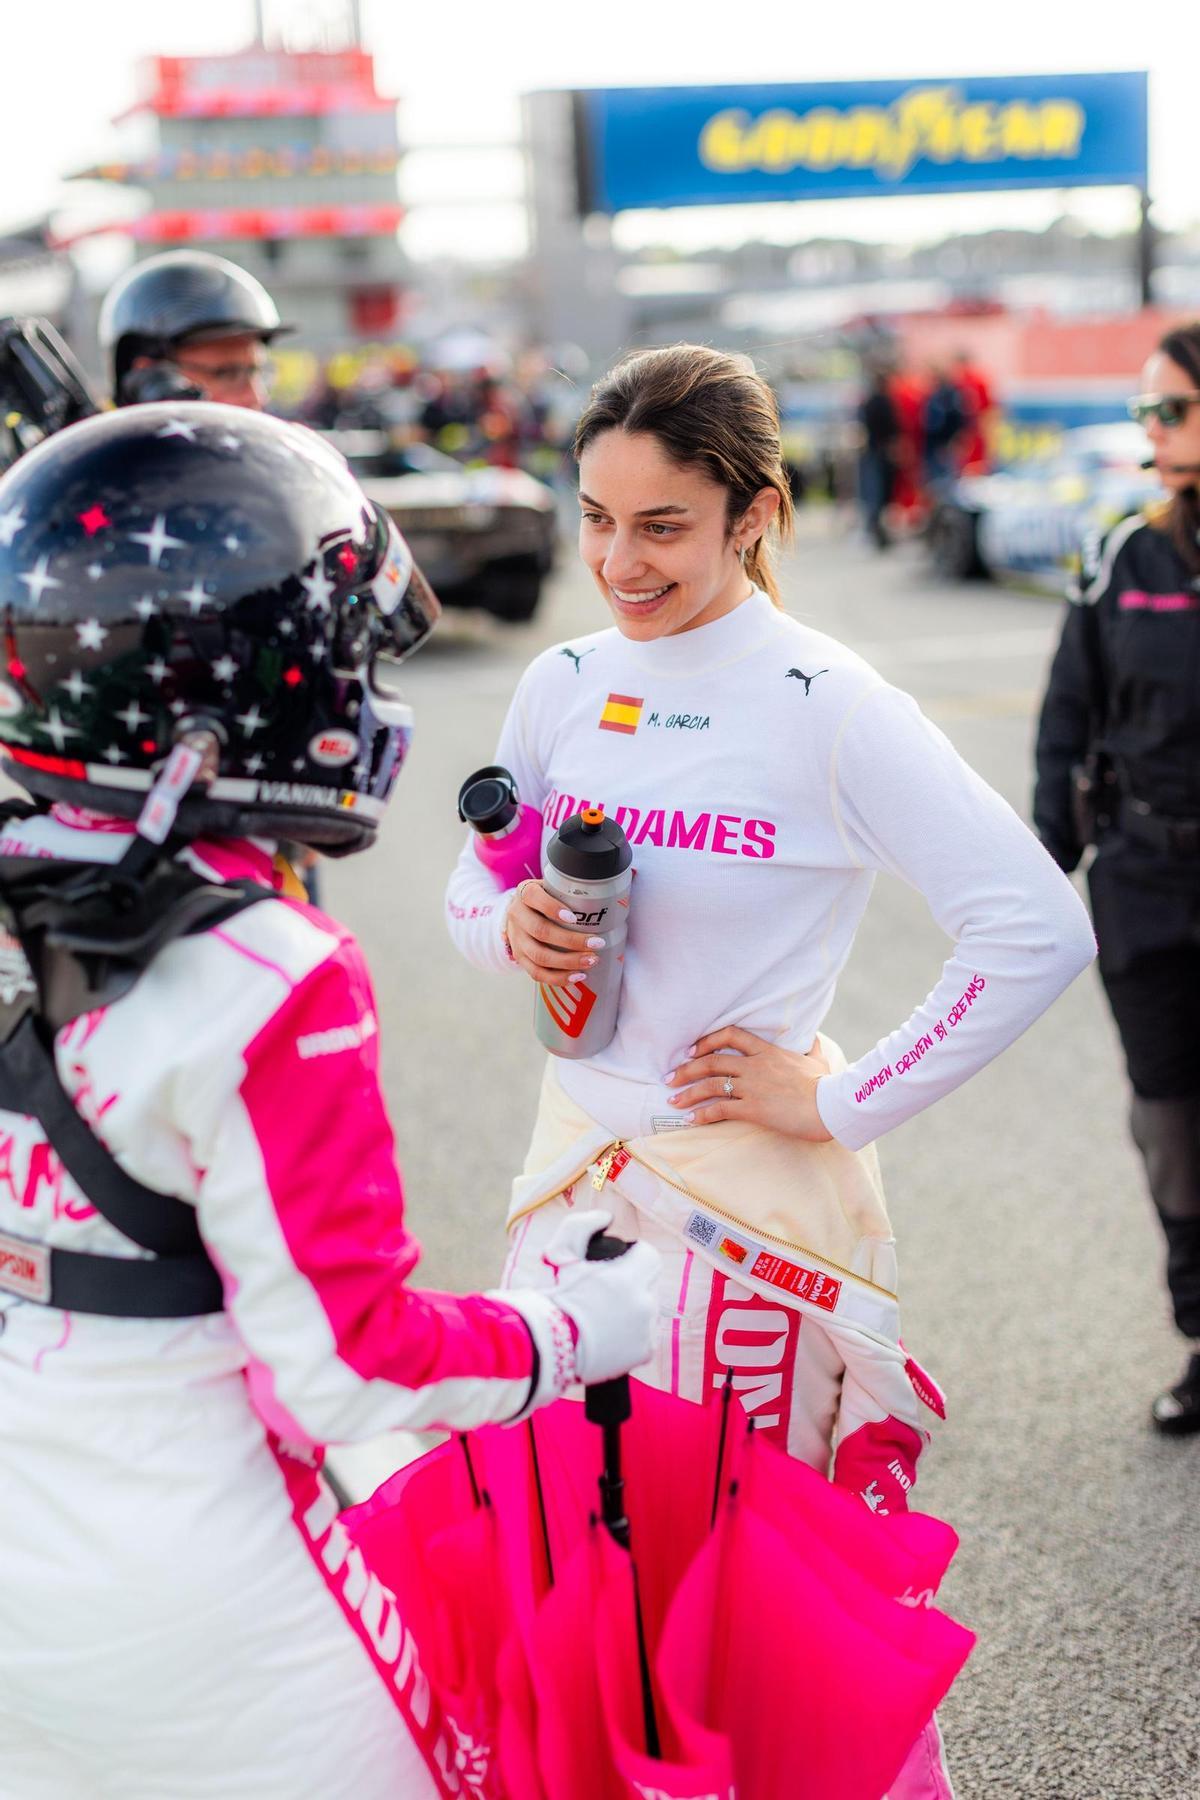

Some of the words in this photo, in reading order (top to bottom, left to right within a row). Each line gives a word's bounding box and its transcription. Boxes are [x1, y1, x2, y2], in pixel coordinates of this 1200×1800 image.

[647, 712, 661, 727] M.
[665, 713, 710, 729] GARCIA
[614, 806, 777, 859] DAMES
[854, 1064, 893, 1103] WOMEN
[895, 1033, 934, 1075] DRIVEN
[933, 1019, 948, 1042] BY
[947, 974, 986, 1027] DREAMS
